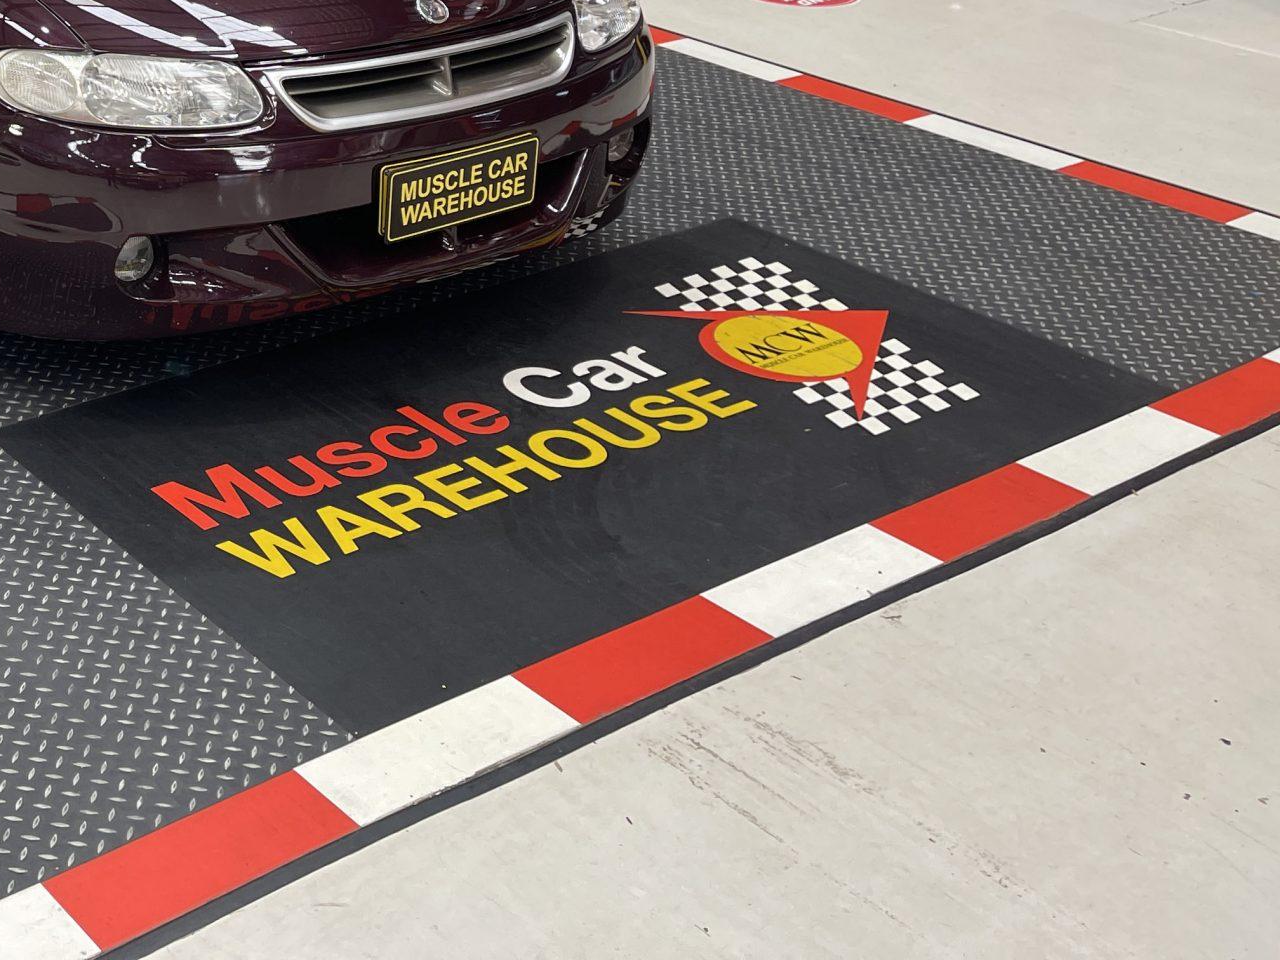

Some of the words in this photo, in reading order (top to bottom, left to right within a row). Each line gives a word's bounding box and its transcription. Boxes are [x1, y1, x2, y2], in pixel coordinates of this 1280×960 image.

[401, 163, 483, 203] MUSCLE
[488, 152, 528, 179] CAR
[401, 175, 526, 226] WAREHOUSE
[735, 323, 830, 365] MCW
[150, 400, 509, 531] Muscle
[502, 344, 667, 409] Car
[216, 377, 758, 579] WAREHOUSE
